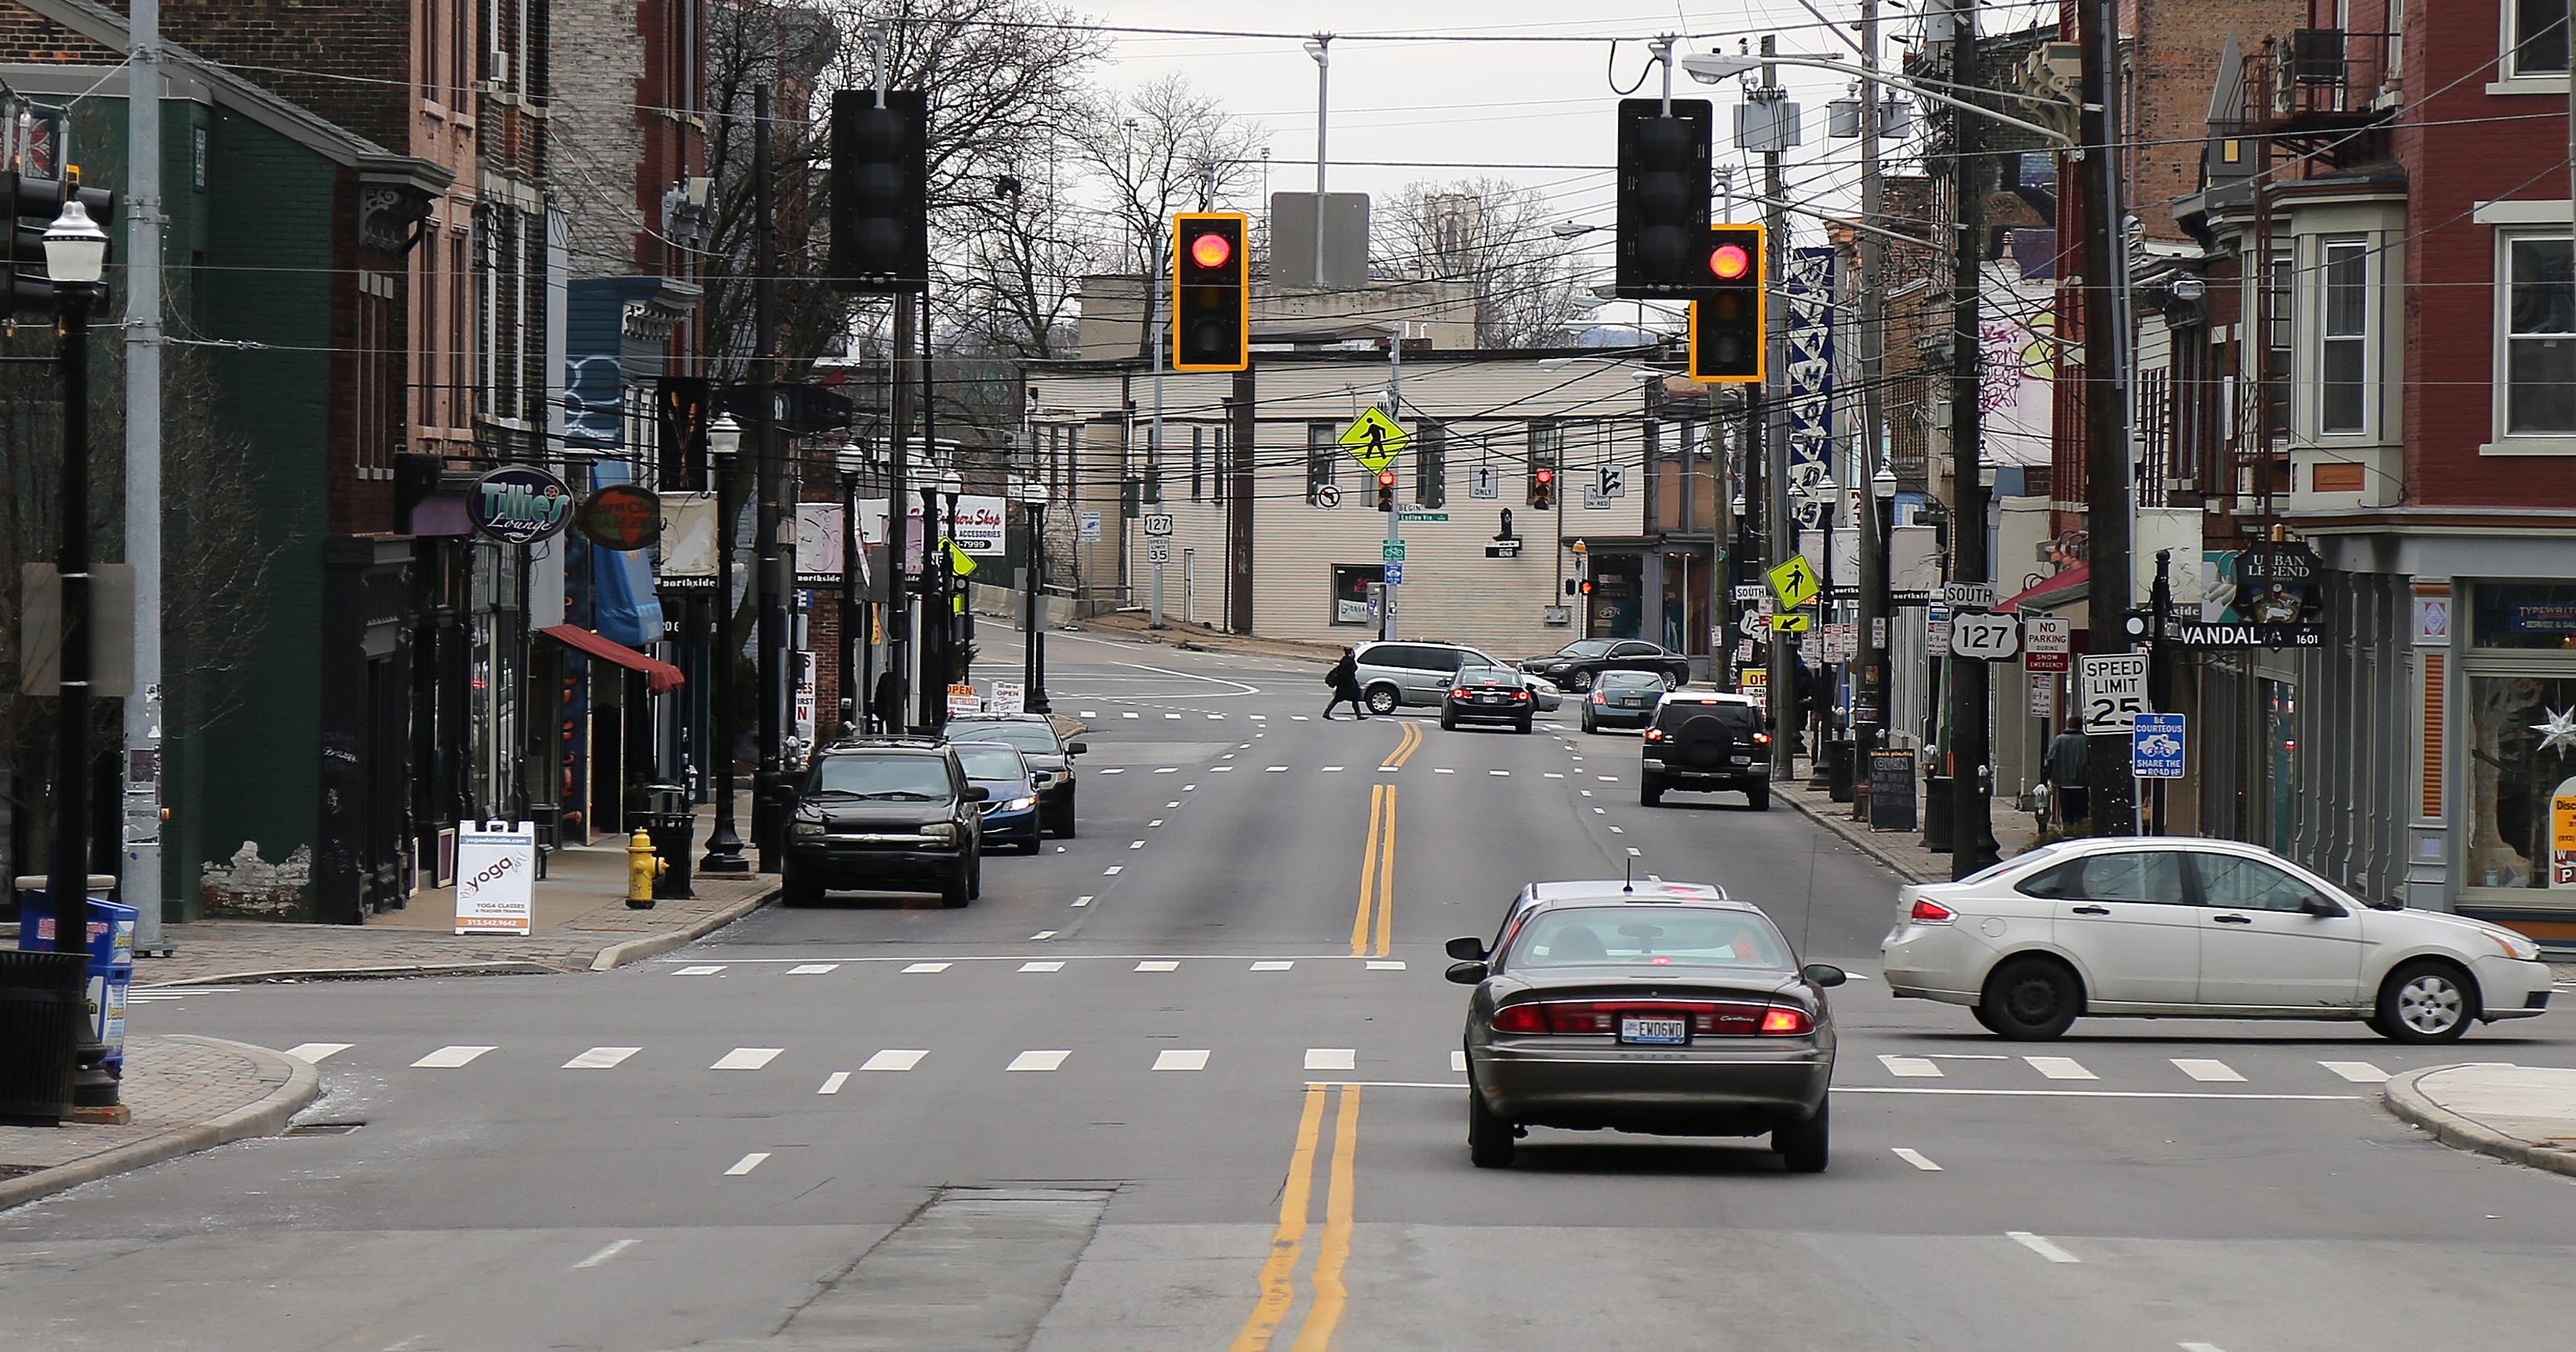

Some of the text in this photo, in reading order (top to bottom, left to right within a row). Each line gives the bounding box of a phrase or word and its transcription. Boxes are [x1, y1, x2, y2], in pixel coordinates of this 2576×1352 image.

[975, 509, 1001, 529] Shop
[1149, 518, 1168, 530] 127
[486, 512, 552, 543] Lounge
[959, 530, 1001, 538] ACCESSORIES
[1150, 550, 1167, 560] 35
[2254, 554, 2306, 567] UBAN
[663, 579, 716, 587] northside
[1738, 588, 1765, 597] SOUTH
[1947, 587, 1992, 603] SOUTH
[2519, 607, 2576, 616] TYPEWRIT
[2040, 622, 2056, 633] NO
[1962, 624, 2008, 649] 127
[2029, 634, 2066, 643] PARKING
[2182, 626, 2262, 645] VANDAL
[2296, 635, 2318, 644] 1601
[2087, 661, 2144, 677] SPEED
[1750, 674, 1767, 685] OP
[2094, 678, 2138, 694] LIMIT
[2091, 698, 2142, 727] 25
[2136, 725, 2182, 733] COURTEOUS
[2148, 768, 2169, 776] ROAD
[467, 857, 513, 892] yoga
